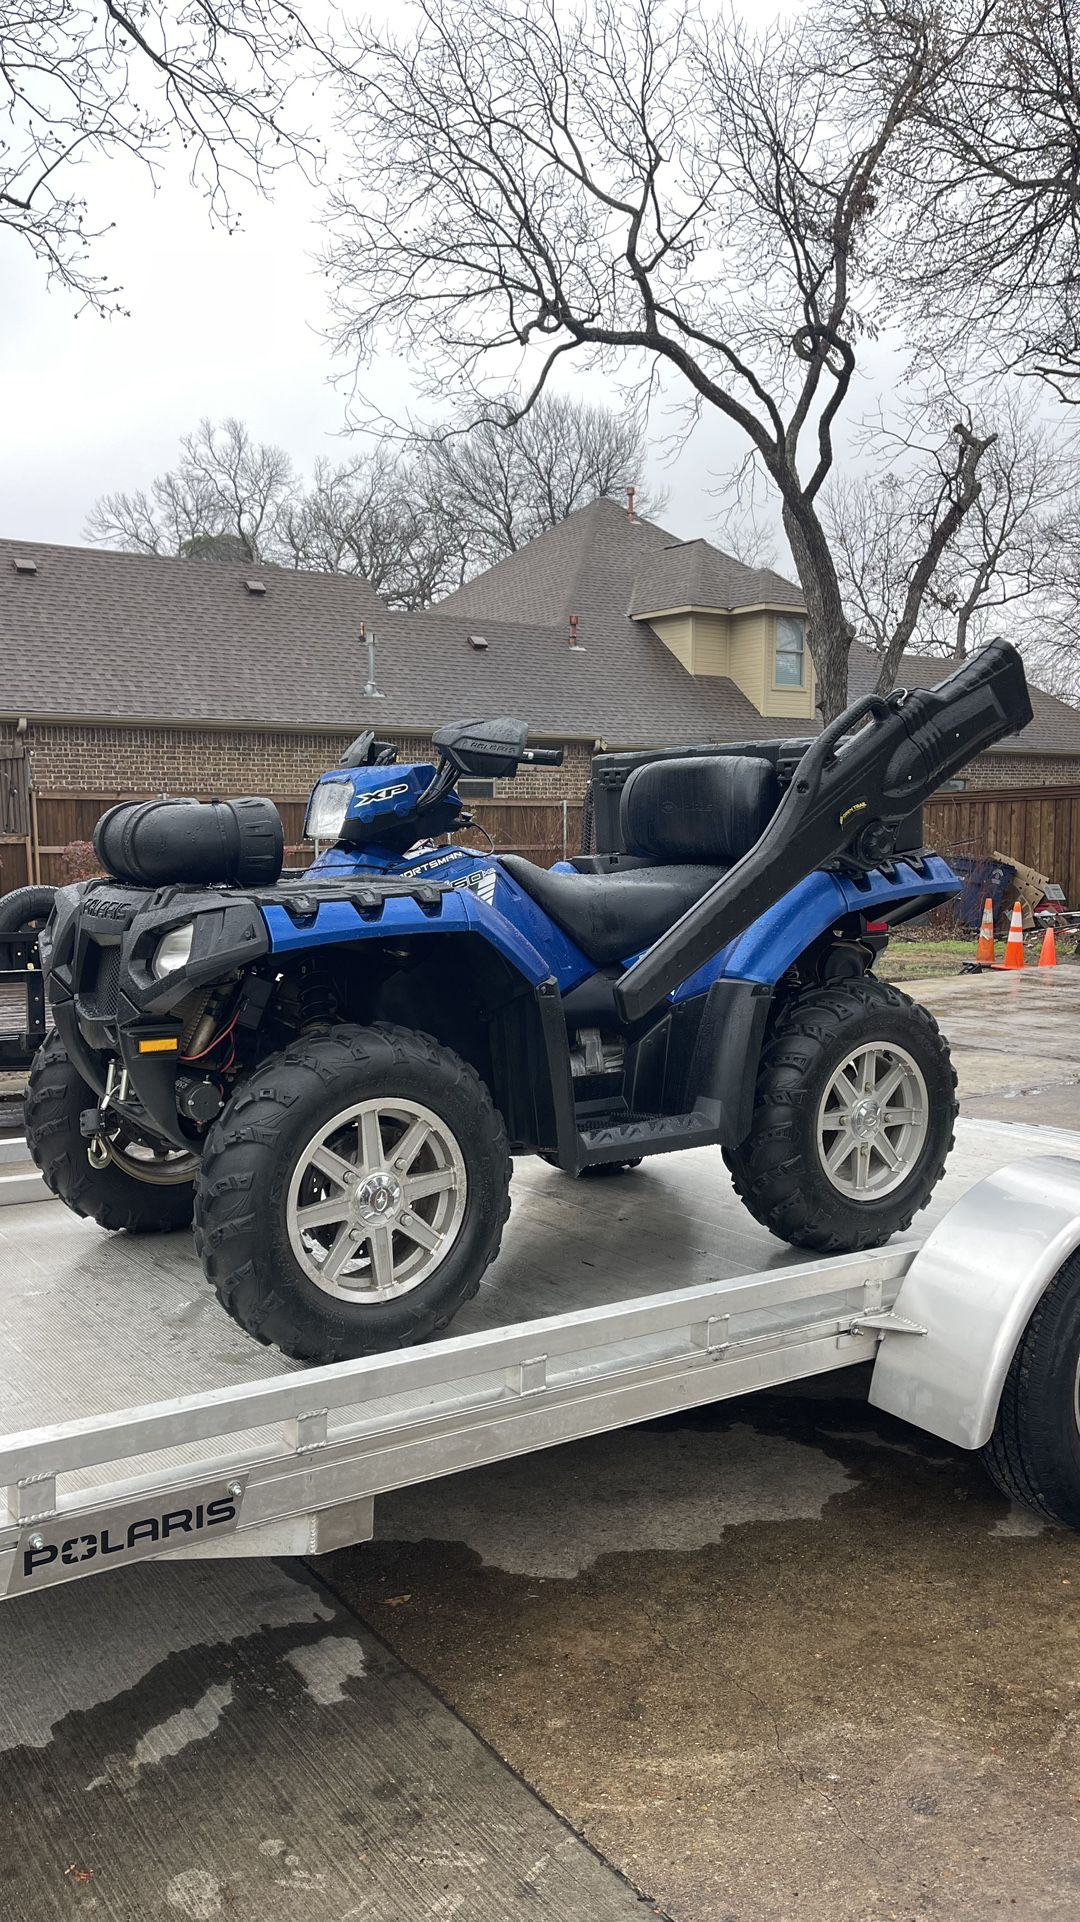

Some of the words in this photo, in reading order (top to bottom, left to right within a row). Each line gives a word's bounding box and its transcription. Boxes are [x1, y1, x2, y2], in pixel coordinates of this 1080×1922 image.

[470, 742, 516, 754] POLARIS
[354, 784, 409, 808] XP
[399, 851, 464, 878] ORTSMAN
[444, 869, 484, 889] 50
[23, 1497, 236, 1577] POLARIS
